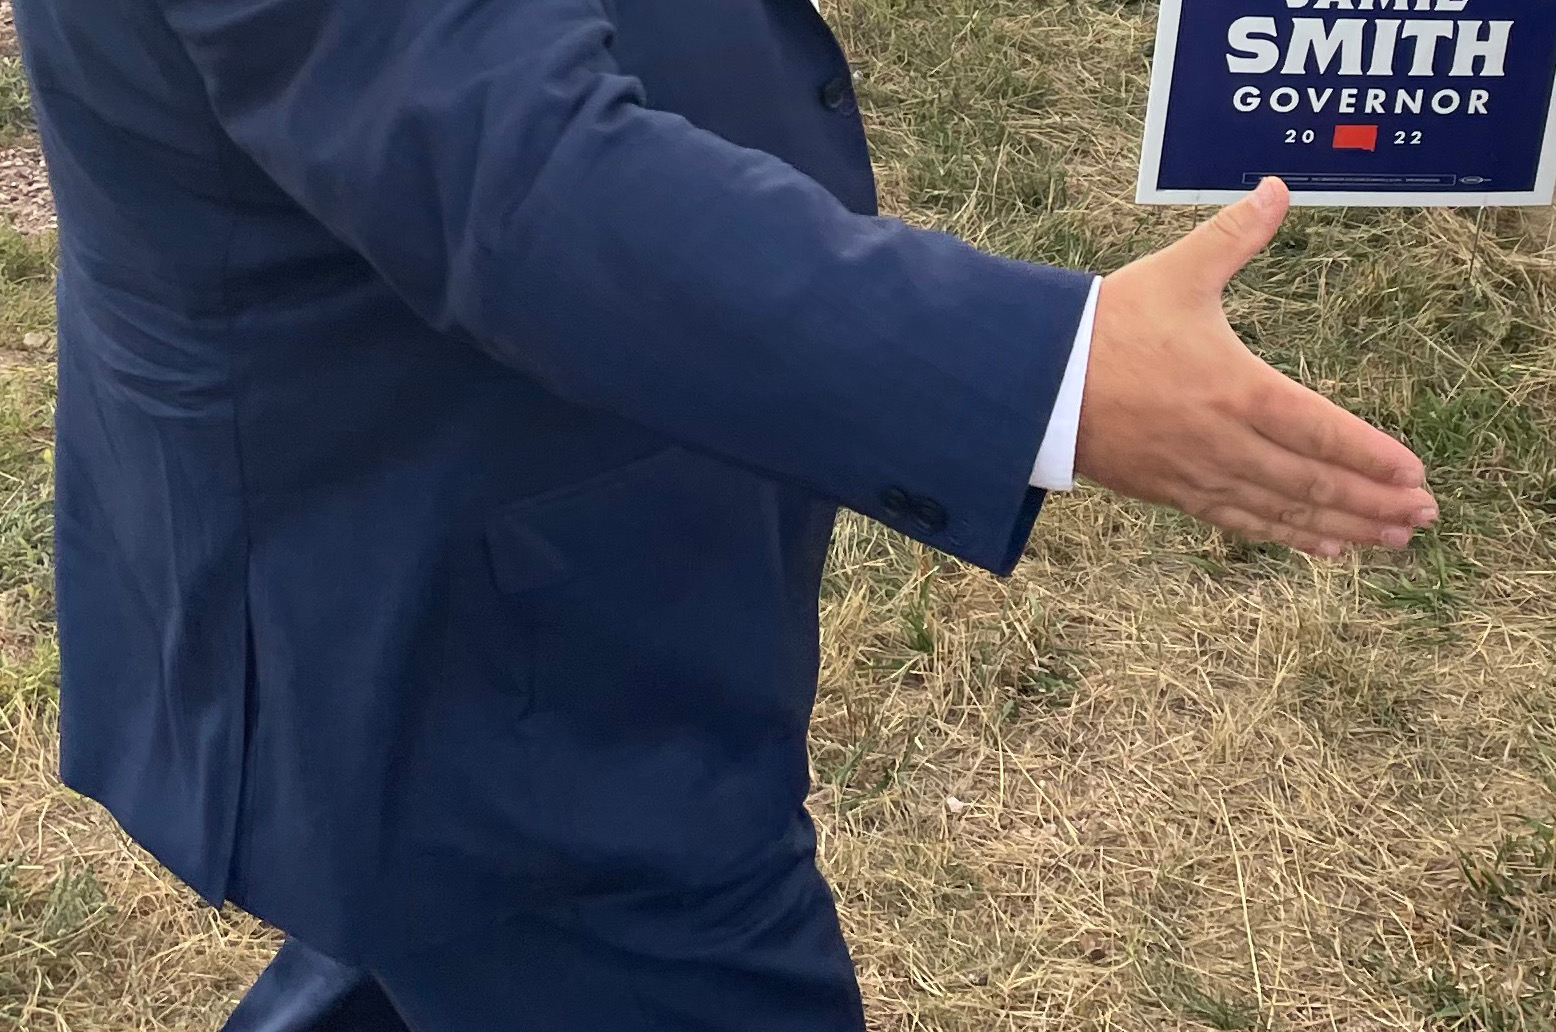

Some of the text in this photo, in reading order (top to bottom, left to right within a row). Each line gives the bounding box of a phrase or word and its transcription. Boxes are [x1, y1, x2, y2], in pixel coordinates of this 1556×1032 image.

[1225, 15, 1515, 78] SMITH
[1232, 85, 1490, 116] GOVERNOR
[1284, 129, 1423, 146] 20 22
